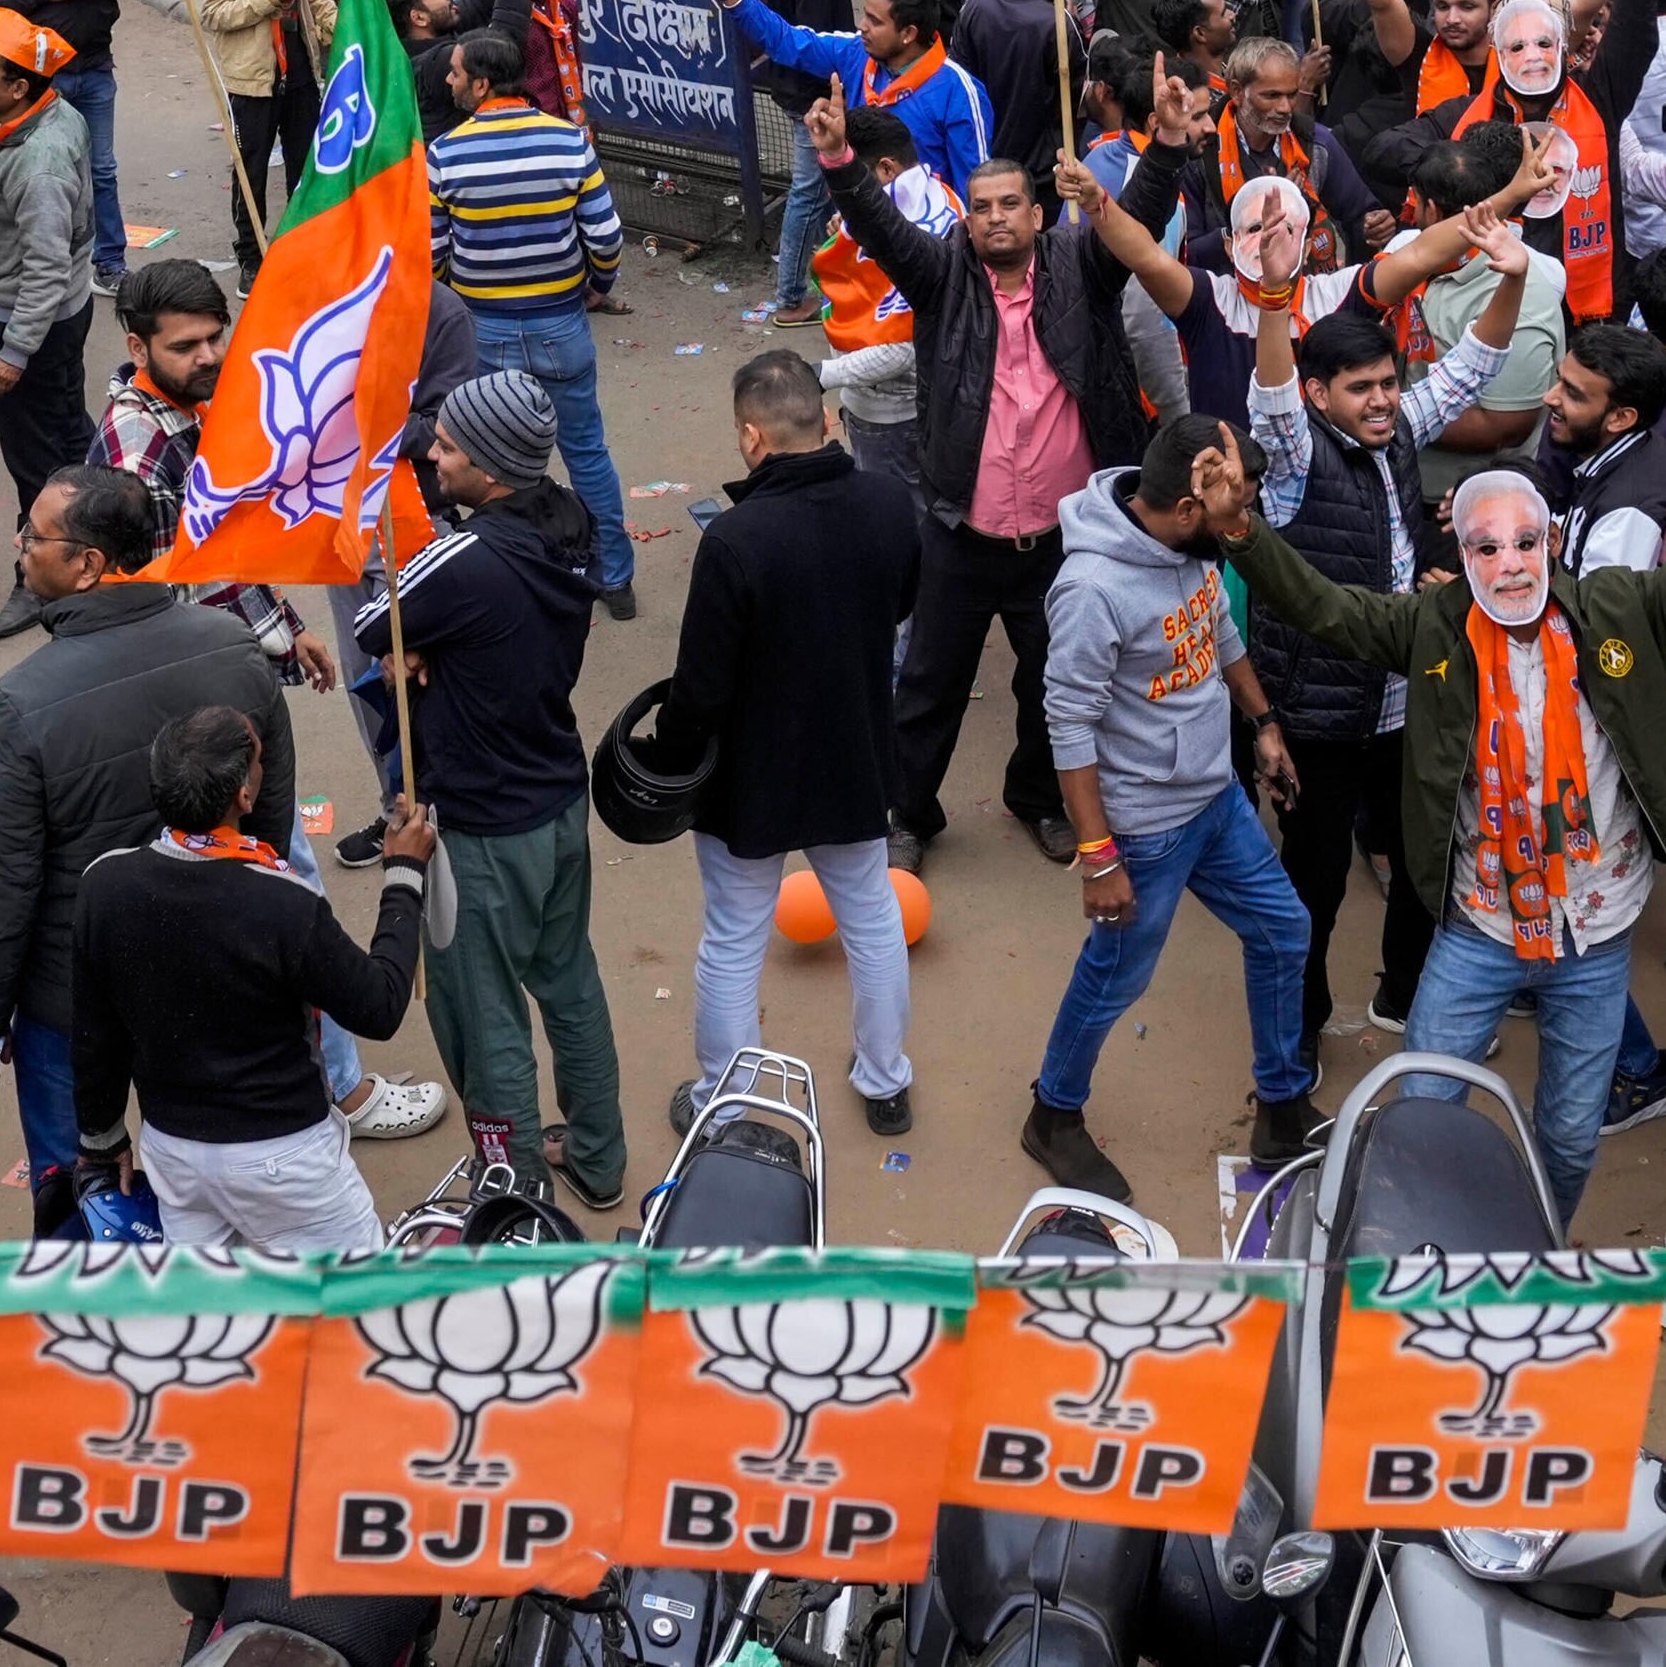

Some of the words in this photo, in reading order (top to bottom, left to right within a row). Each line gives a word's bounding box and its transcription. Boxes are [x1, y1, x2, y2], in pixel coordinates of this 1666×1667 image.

[1567, 221, 1607, 251] BJP
[471, 1120, 510, 1133] adidas
[977, 1428, 1207, 1499] BJP
[1366, 1447, 1593, 1506] BJP
[12, 1465, 250, 1541] BJP
[337, 1493, 574, 1568] BJP
[662, 1482, 898, 1560] BJP
